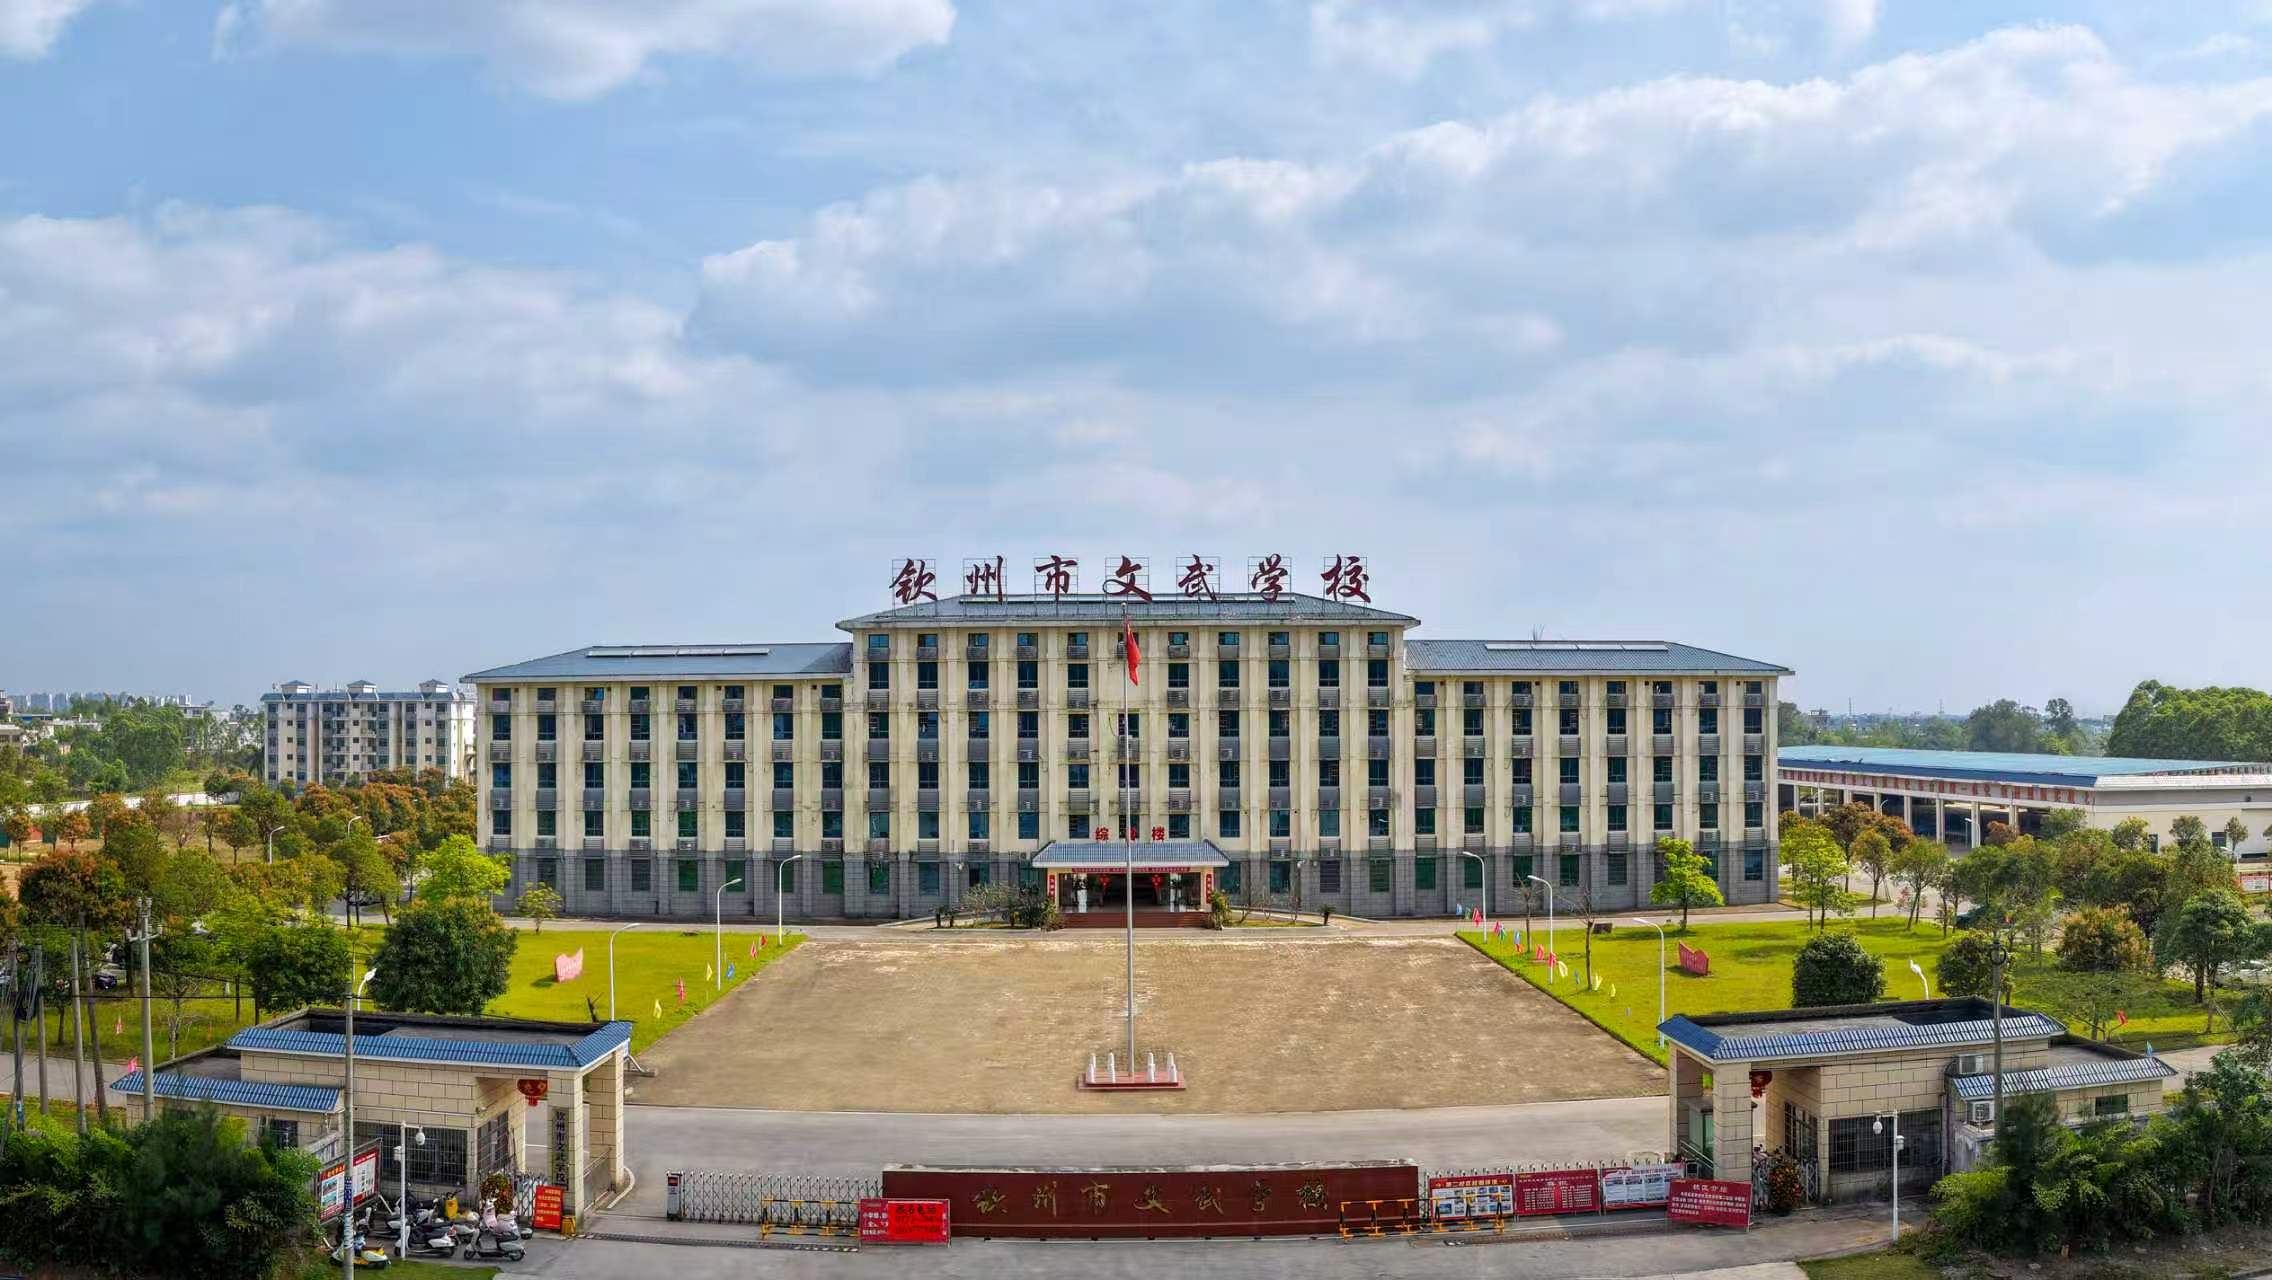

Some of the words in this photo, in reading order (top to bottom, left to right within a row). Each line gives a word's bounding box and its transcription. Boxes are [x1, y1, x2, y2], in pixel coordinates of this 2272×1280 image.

[890, 553, 1371, 604] 钦州市文武学校
